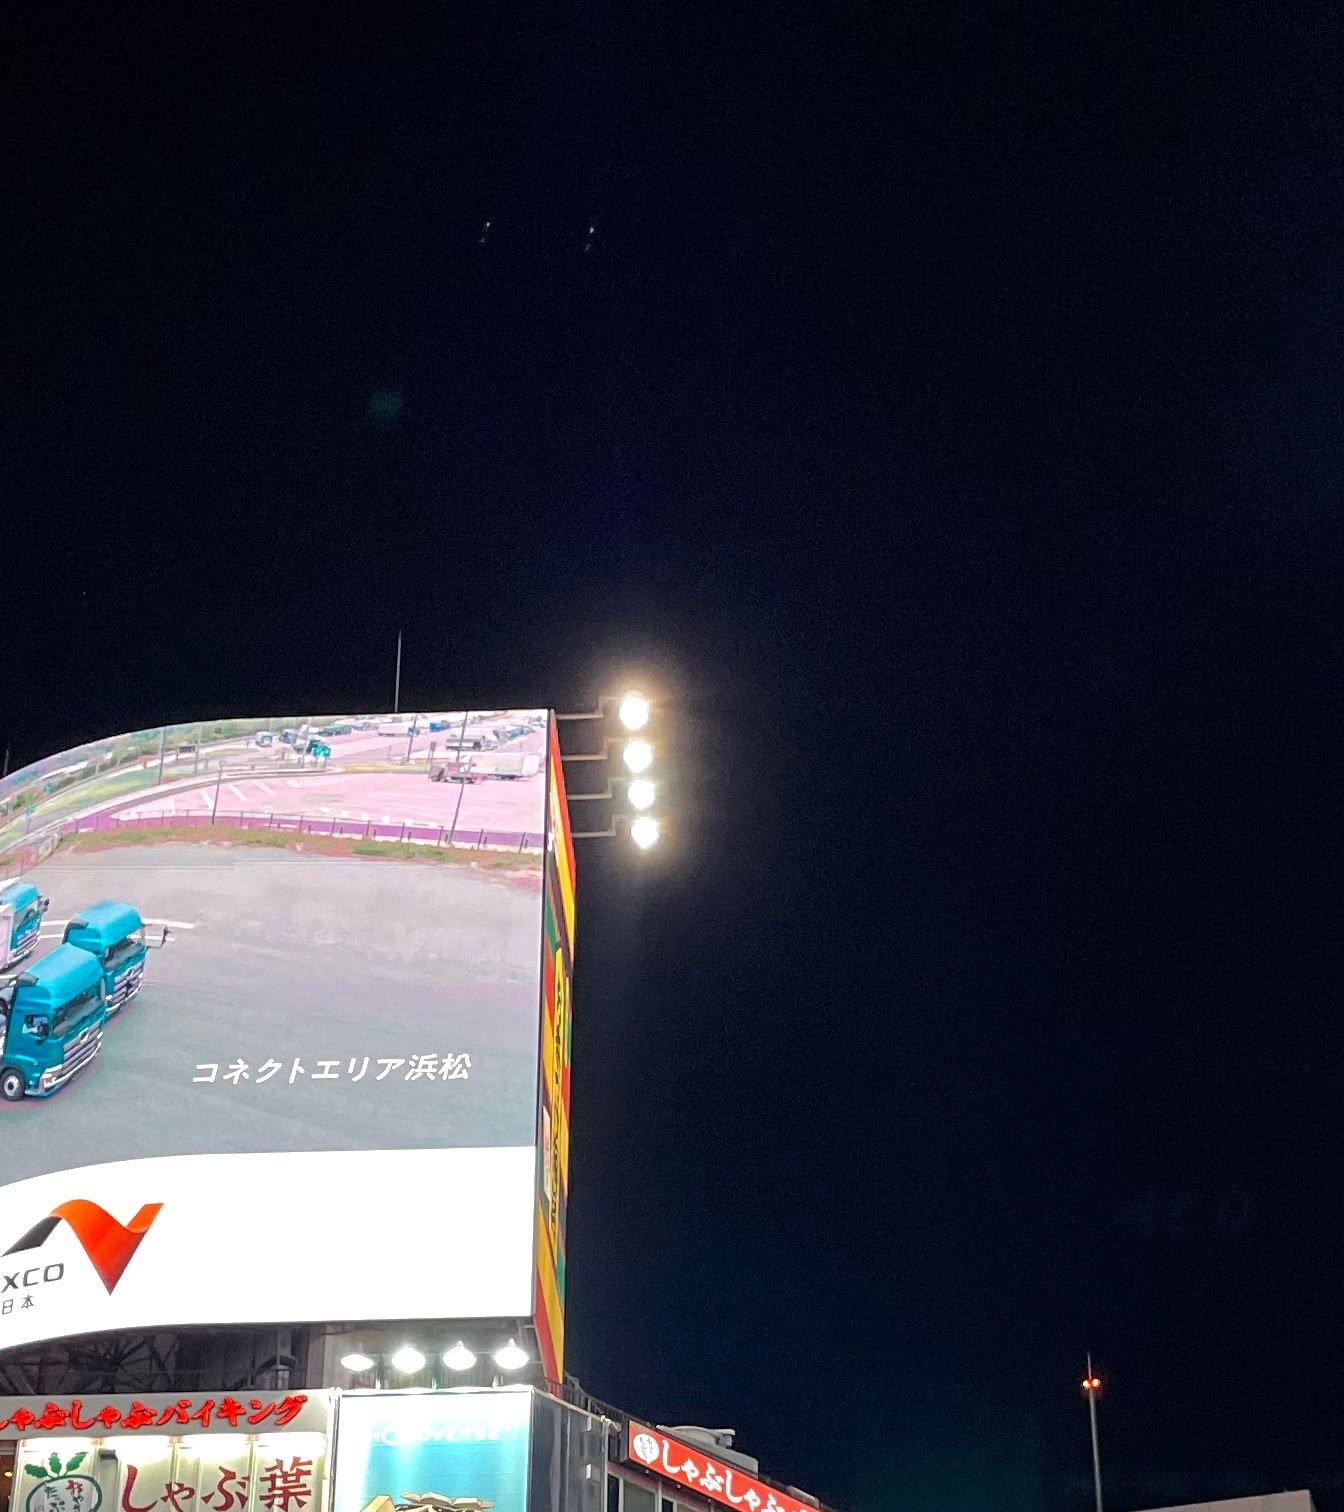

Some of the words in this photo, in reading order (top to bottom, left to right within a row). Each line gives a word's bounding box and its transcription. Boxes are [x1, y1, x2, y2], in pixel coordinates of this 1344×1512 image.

[191, 1053, 471, 1085] コネクトエリア浜松
